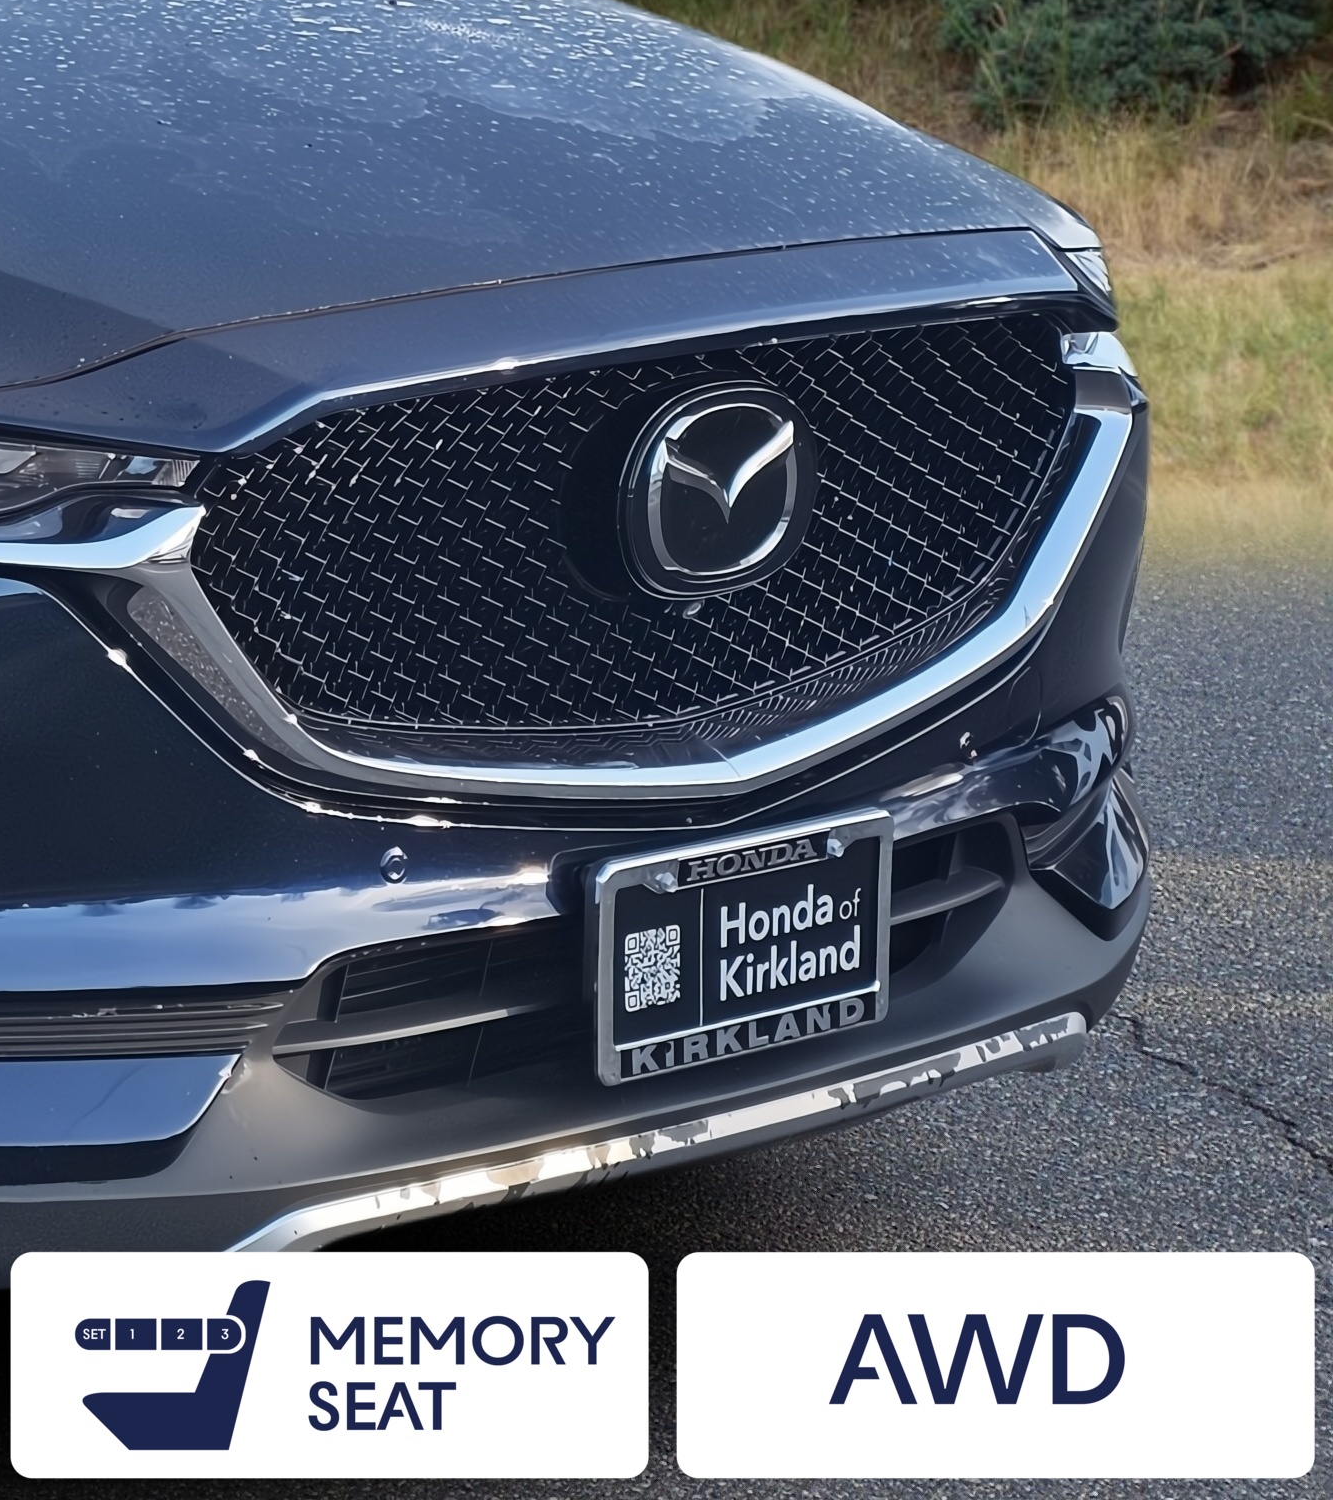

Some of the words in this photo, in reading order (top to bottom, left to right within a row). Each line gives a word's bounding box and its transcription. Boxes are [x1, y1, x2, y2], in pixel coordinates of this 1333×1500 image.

[686, 837, 818, 883] HONDA
[720, 883, 834, 949] Honda
[838, 887, 862, 921] of
[719, 924, 861, 1002] Kirkland
[631, 997, 866, 1076] KIRKLAND
